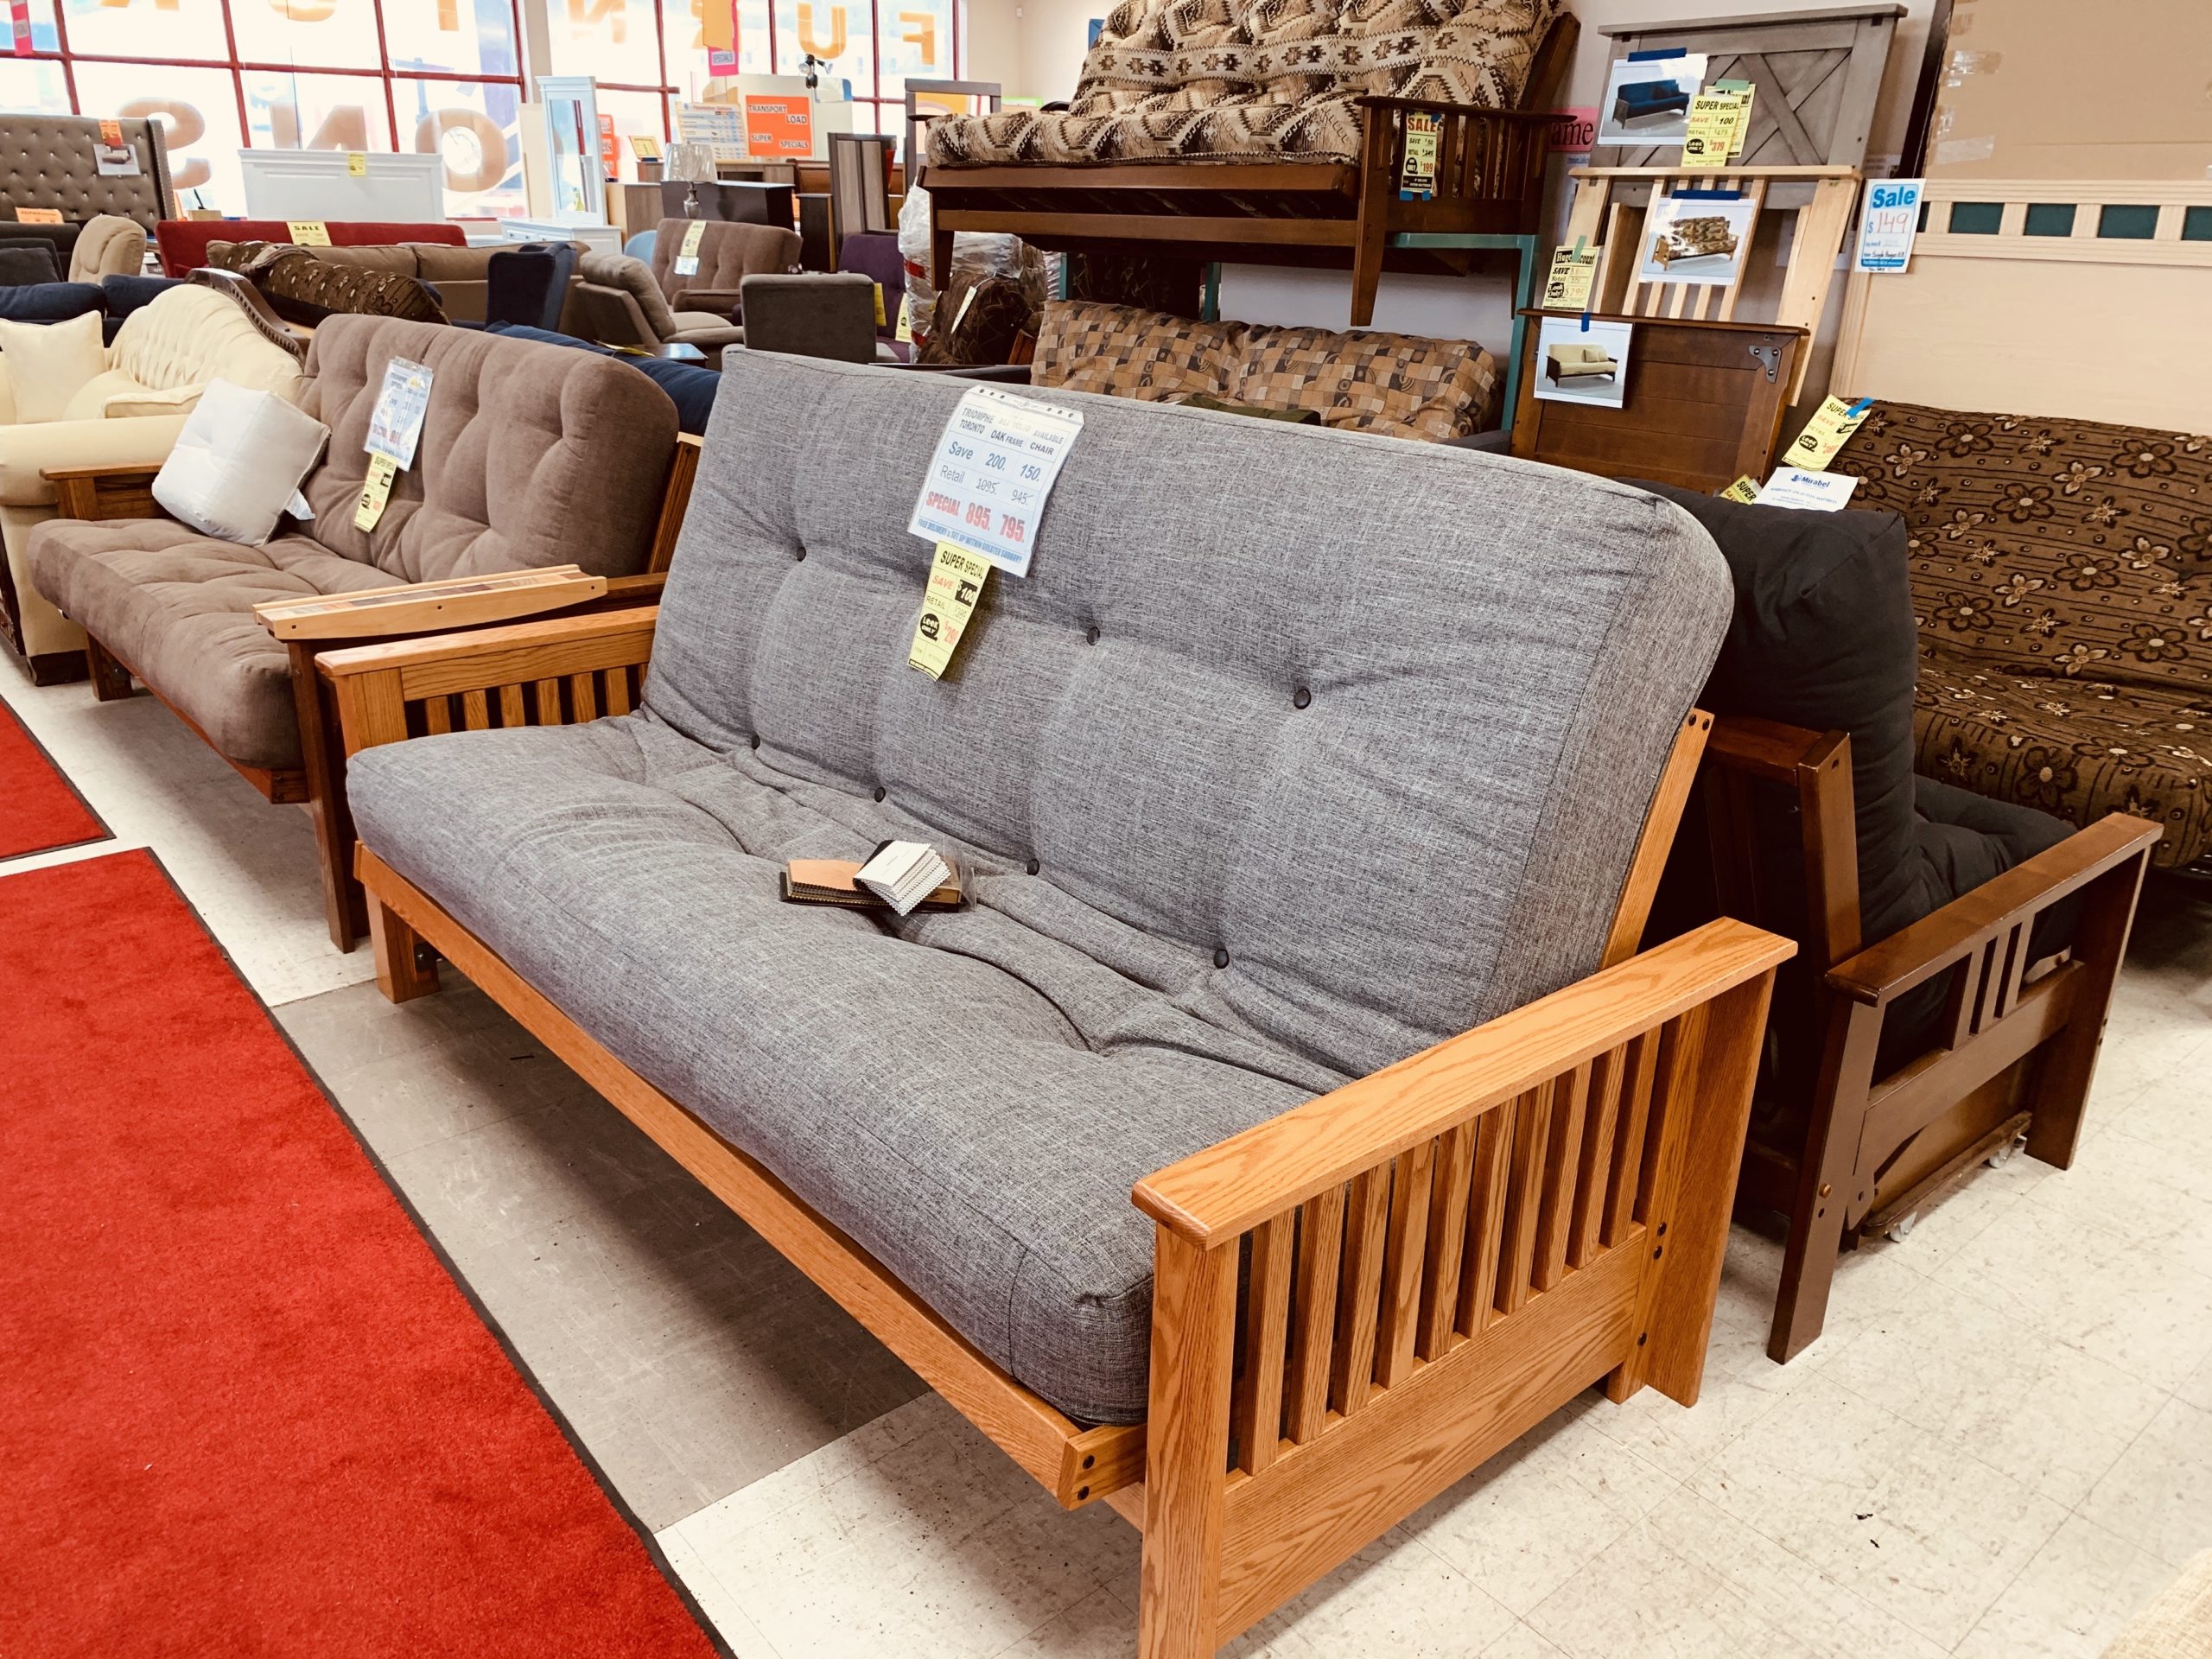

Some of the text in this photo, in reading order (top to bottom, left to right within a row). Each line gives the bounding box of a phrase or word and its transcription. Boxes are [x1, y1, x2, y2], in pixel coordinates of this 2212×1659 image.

[713, 53, 734, 64] SPECIALS
[748, 105, 786, 113] TRANSPORT
[1695, 100, 1719, 110] SUPER
[1408, 118, 1436, 132] SALE
[1552, 123, 1593, 145] ame
[1872, 187, 1916, 208] Sale
[1827, 402, 1847, 418] SUPER
[962, 407, 995, 424] TRIOMPHE
[1033, 429, 1065, 444] AVAILABLE
[1816, 414, 1834, 426] SAVE
[959, 419, 1054, 455] TORONTO OAK FRAME CHAIR
[949, 441, 1041, 481] Save 200. 150.
[940, 465, 965, 484] Retail
[1802, 475, 1831, 487] Mirabel
[1737, 481, 1757, 501] SUPER
[925, 491, 1026, 543] SPECIAL 895. 795.
[940, 550, 983, 580] SUPER SPECIAL
[932, 575, 954, 590] SAVE
[926, 595, 945, 610] RETAIL
